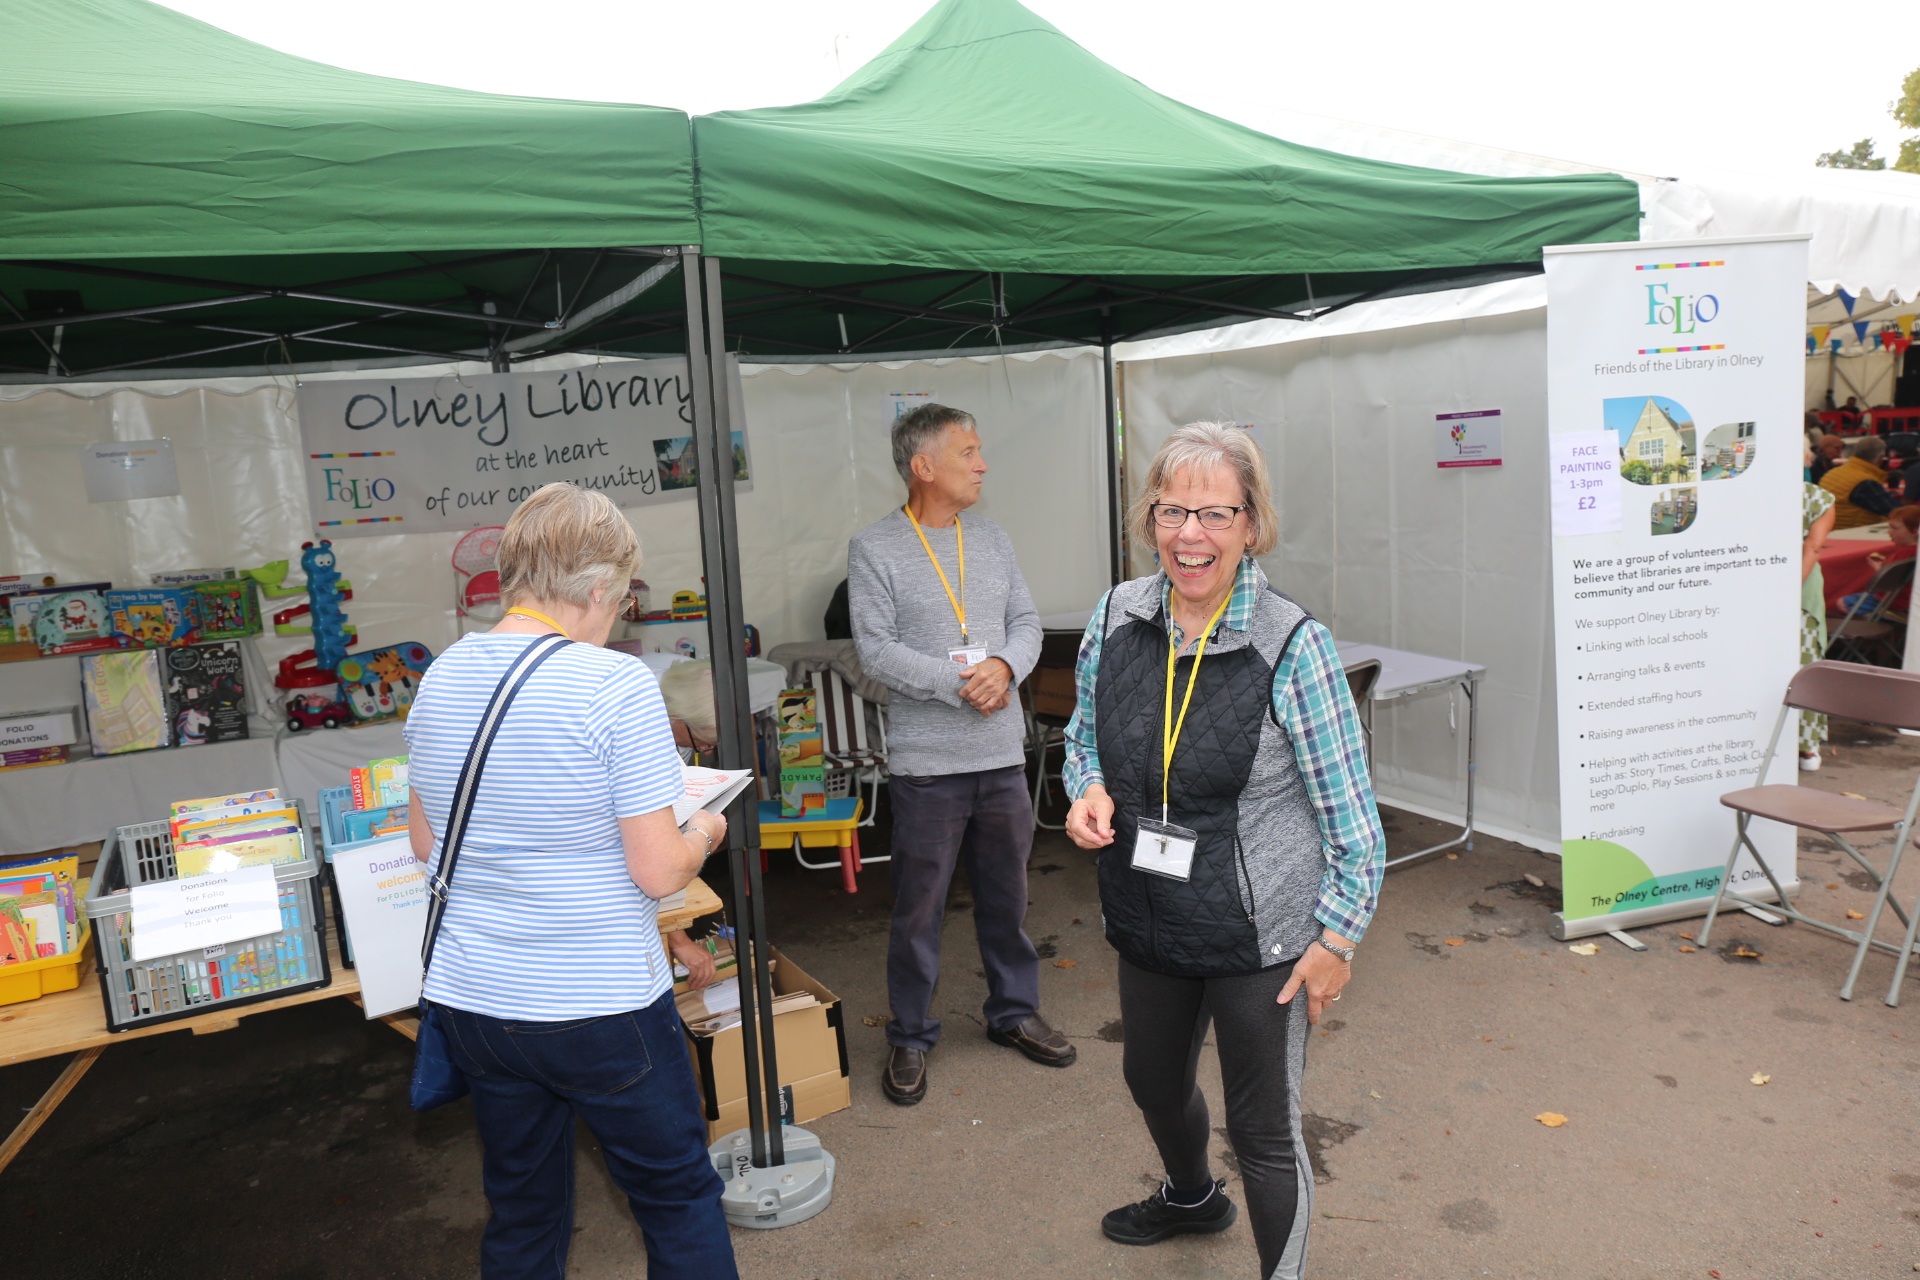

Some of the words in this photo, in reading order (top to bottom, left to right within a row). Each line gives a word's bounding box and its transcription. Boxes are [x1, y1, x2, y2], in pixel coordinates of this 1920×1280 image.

[1594, 362, 1637, 375] Friends
[1639, 360, 1650, 372] of
[1654, 360, 1672, 371] the
[1675, 357, 1715, 371] Library
[1717, 356, 1727, 367] in
[1732, 354, 1763, 367] Olney
[346, 386, 509, 446] Olney
[528, 371, 692, 423] Library
[476, 453, 500, 471] at
[505, 445, 537, 469] the
[545, 438, 609, 465] heart
[1572, 446, 1598, 457] FACE
[1560, 461, 1611, 473] PAINTING
[426, 488, 451, 517] of
[458, 486, 497, 509] our
[508, 466, 655, 502] counity
[1570, 479, 1603, 491] 1-3pm
[1578, 496, 1596, 510] £2
[1573, 559, 1592, 569] We
[1596, 558, 1613, 568] are
[1617, 557, 1622, 566] a
[1625, 553, 1654, 568] group
[1658, 551, 1669, 561] of
[1673, 546, 1725, 560] volunteers
[1729, 545, 1748, 553] who
[1574, 572, 1614, 584] believe
[1618, 569, 1637, 580] that
[1641, 565, 1682, 578] libraries
[1685, 564, 1701, 573] are
[1704, 558, 1752, 573] important
[1755, 557, 1766, 566] to
[1770, 555, 1787, 564] the
[138, 593, 147, 601] by
[1575, 586, 1633, 599] community
[1637, 582, 1654, 593] and
[1658, 582, 1674, 591] our
[1679, 578, 1712, 589] future.
[1575, 619, 1593, 629] We
[1596, 615, 1635, 630] support
[1637, 612, 1666, 624] Olney
[1669, 607, 1702, 621] Library
[1705, 606, 1720, 616] by:
[1586, 640, 1622, 653] Linking
[1625, 638, 1645, 648] with
[1648, 634, 1669, 644] local
[1673, 630, 1708, 642] schools
[201, 657, 238, 667] Unicorn
[207, 665, 234, 675] World
[1587, 668, 1636, 682] Arranging
[1639, 665, 1661, 676] talks
[1663, 663, 1671, 672] &
[1674, 660, 1705, 671] events
[1588, 697, 1634, 711] Extended
[1637, 692, 1673, 707] staffing
[1676, 689, 1702, 700] hours
[6, 725, 34, 733] FOLIO
[1589, 727, 1623, 740] Raising
[1626, 722, 1675, 736] awareness
[1678, 719, 1686, 728] in
[1689, 716, 1704, 727] the
[1706, 709, 1757, 724] community
[0, 734, 49, 746] ONATIONS
[1589, 758, 1627, 772] Helping
[1630, 755, 1649, 765] with
[1652, 748, 1693, 762] activities
[1696, 746, 1705, 754] at
[1708, 742, 1723, 752] the
[1725, 739, 1755, 752] library
[1589, 773, 1611, 784] such
[1615, 770, 1627, 780] as:
[1630, 766, 1656, 779] Story
[1658, 762, 1688, 774] Times,
[1691, 757, 1721, 770] Crafts,
[1724, 751, 1748, 764] Book
[1751, 748, 1779, 760] Clus,
[1590, 782, 1649, 799] Lego/Duplo,
[1652, 778, 1671, 790] Play
[1674, 771, 1713, 784] Sessions
[1716, 770, 1722, 779] &
[1725, 768, 1736, 776] so
[1590, 802, 1615, 812] more
[1590, 825, 1645, 840] Fundraising
[181, 878, 227, 891] Donations
[377, 871, 426, 889] welcome
[203, 891, 224, 899] Folio
[1592, 896, 1611, 907] The
[1615, 890, 1648, 904] Olney
[1651, 882, 1690, 898] Centre,
[1695, 875, 1720, 889] High
[184, 903, 228, 915] Welcome
[393, 901, 410, 909] Thank
[183, 918, 212, 928] Thank
[215, 915, 232, 923] you
